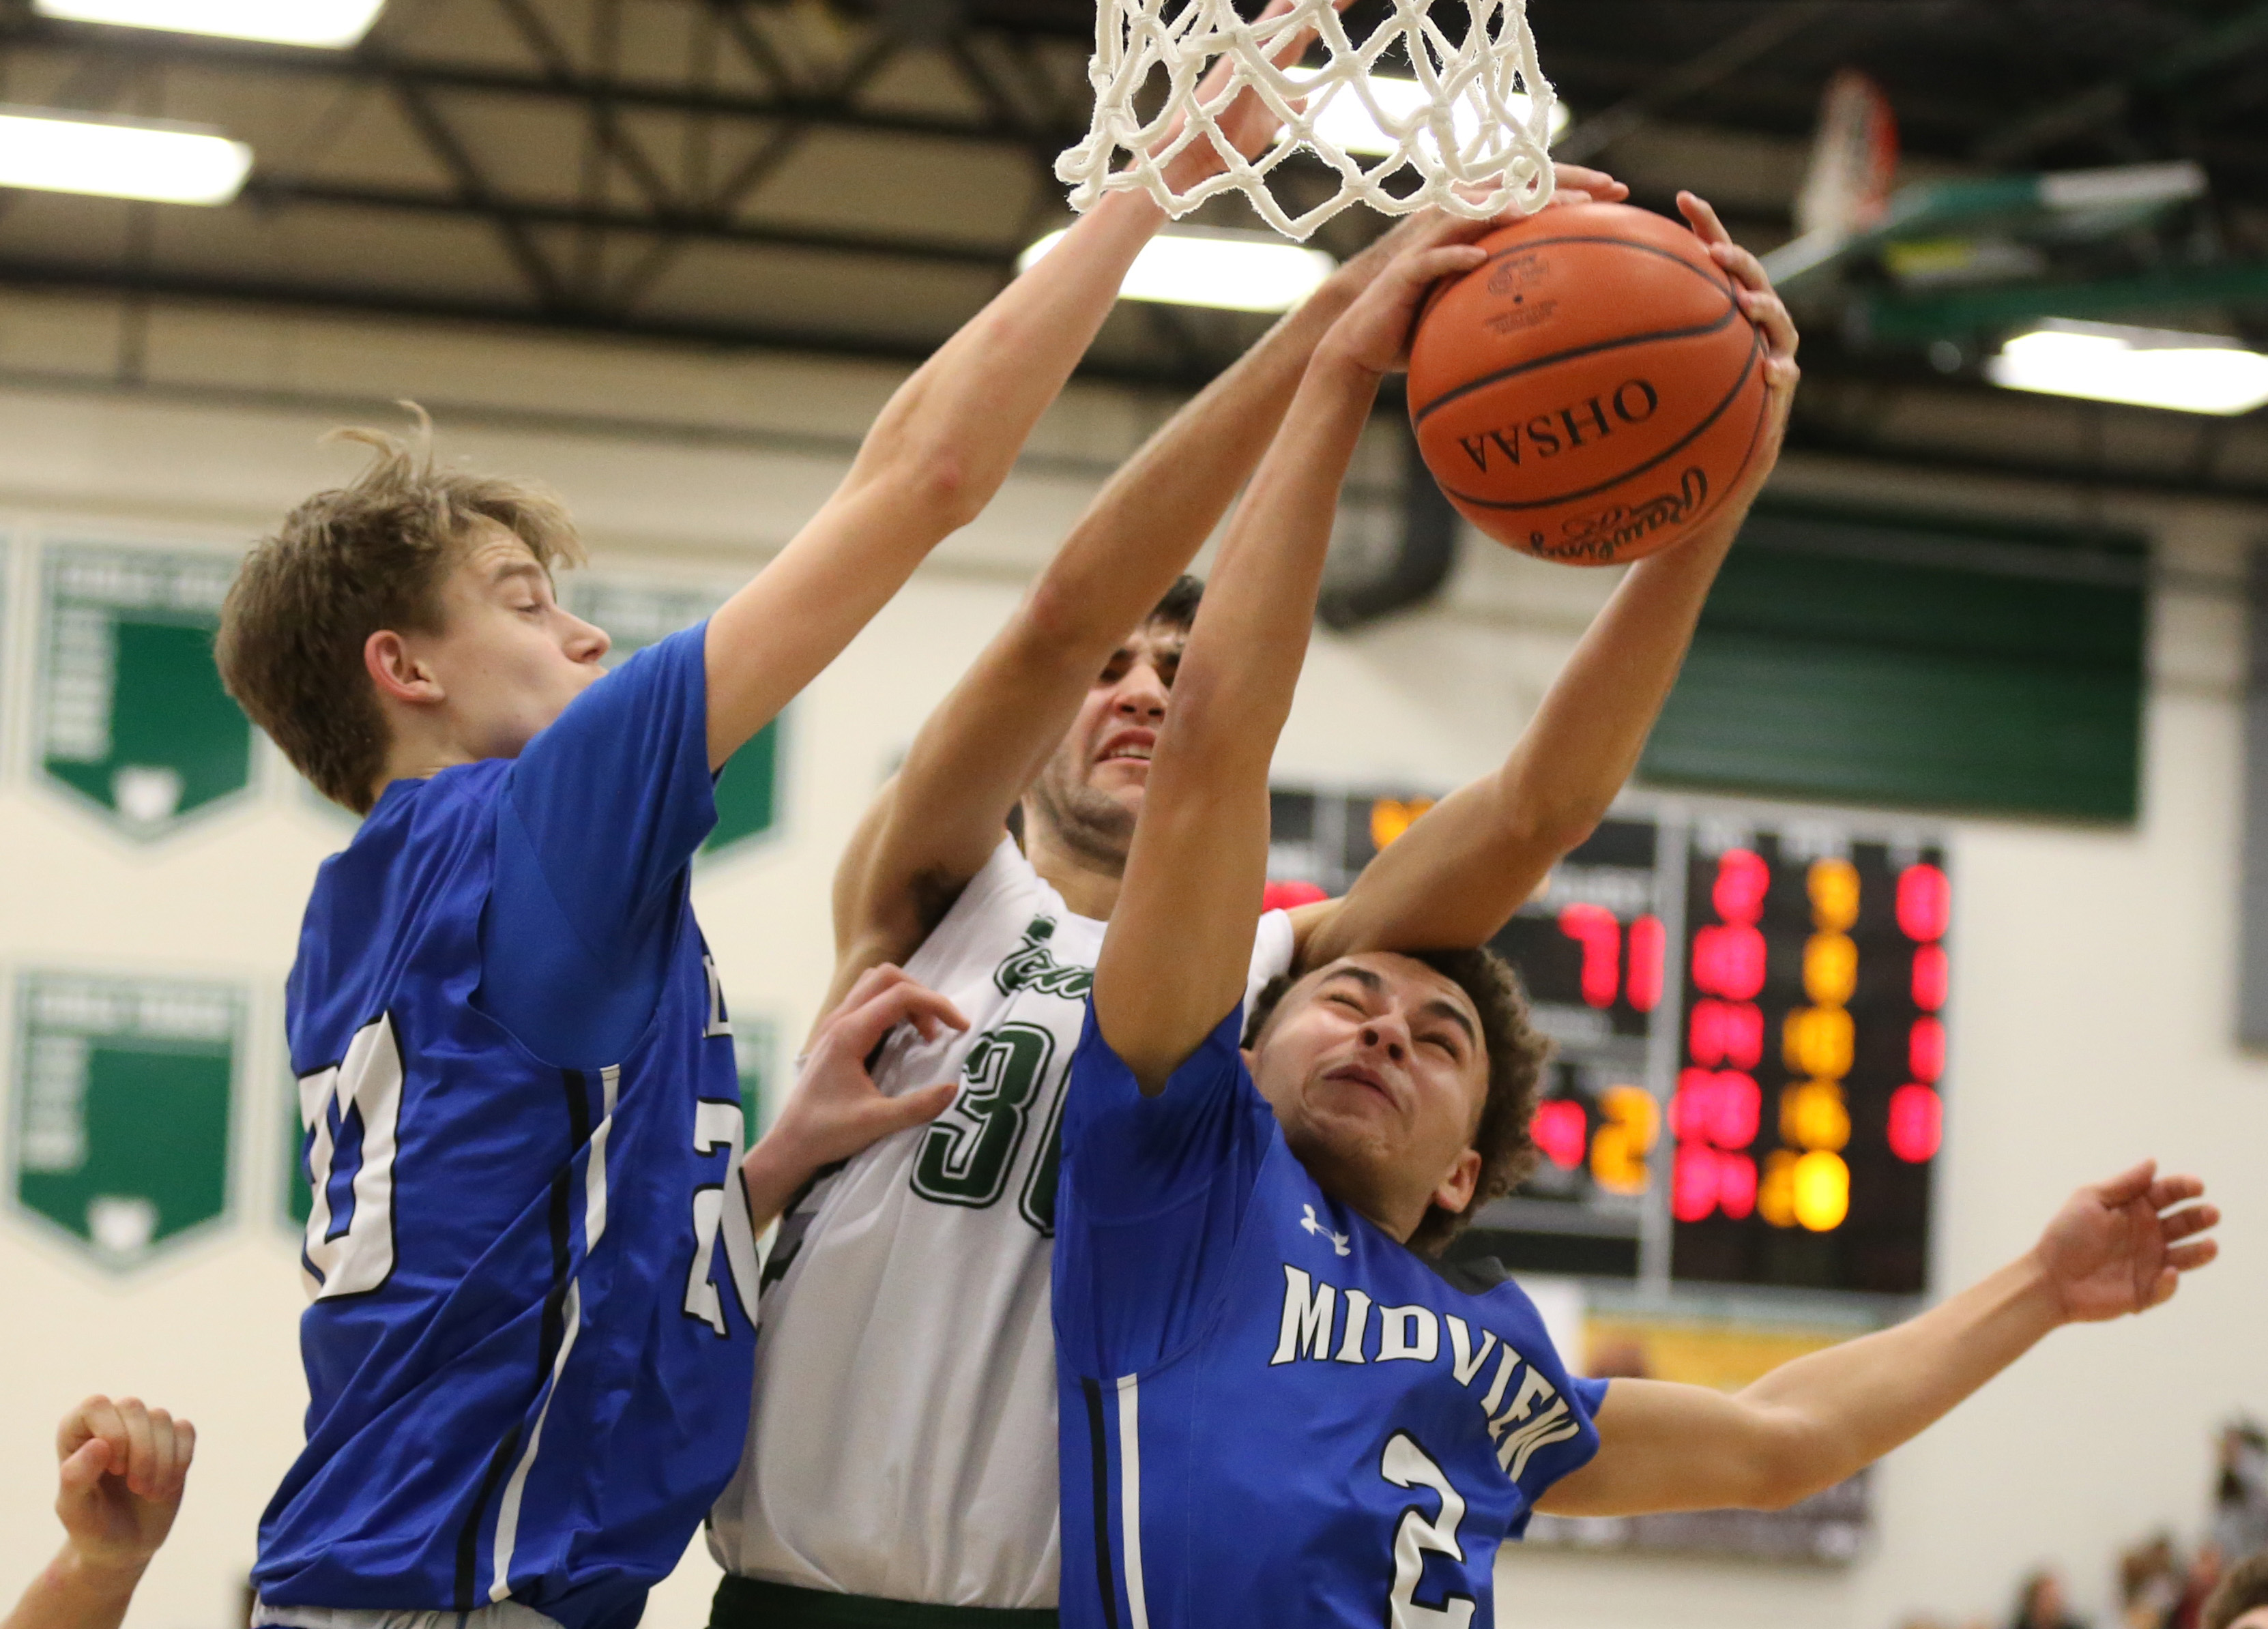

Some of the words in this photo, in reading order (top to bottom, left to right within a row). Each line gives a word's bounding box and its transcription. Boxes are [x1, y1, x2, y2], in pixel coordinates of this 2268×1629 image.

[1458, 379, 1659, 473] OHSAA
[1530, 467, 1708, 560] Rawling
[1268, 1263, 1582, 1484] MIDVIEW
